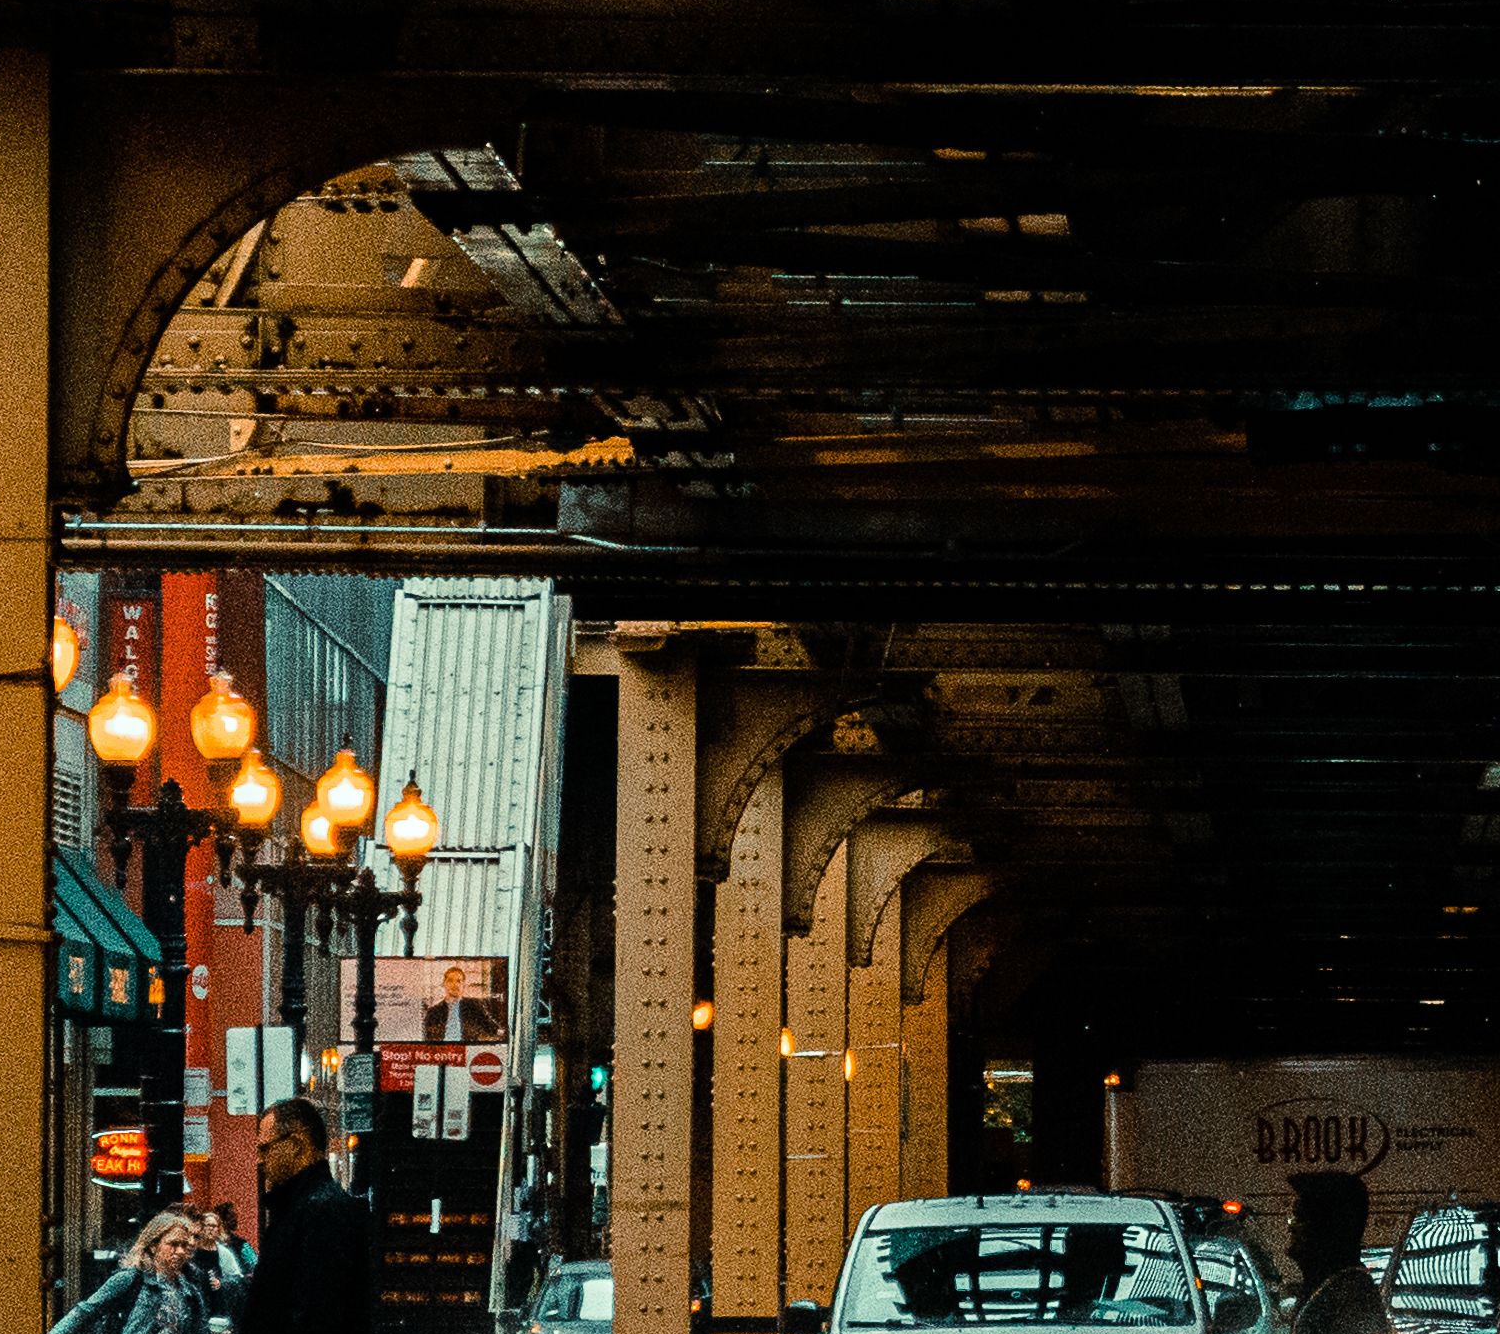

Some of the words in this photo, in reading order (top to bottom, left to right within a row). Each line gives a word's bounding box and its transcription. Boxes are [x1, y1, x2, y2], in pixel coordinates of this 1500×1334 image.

[122, 605, 143, 693] WALG
[380, 1051, 412, 1063] Stop!
[414, 1051, 431, 1062] No
[433, 1052, 463, 1064] entry
[1253, 1115, 1368, 1164] BROOK
